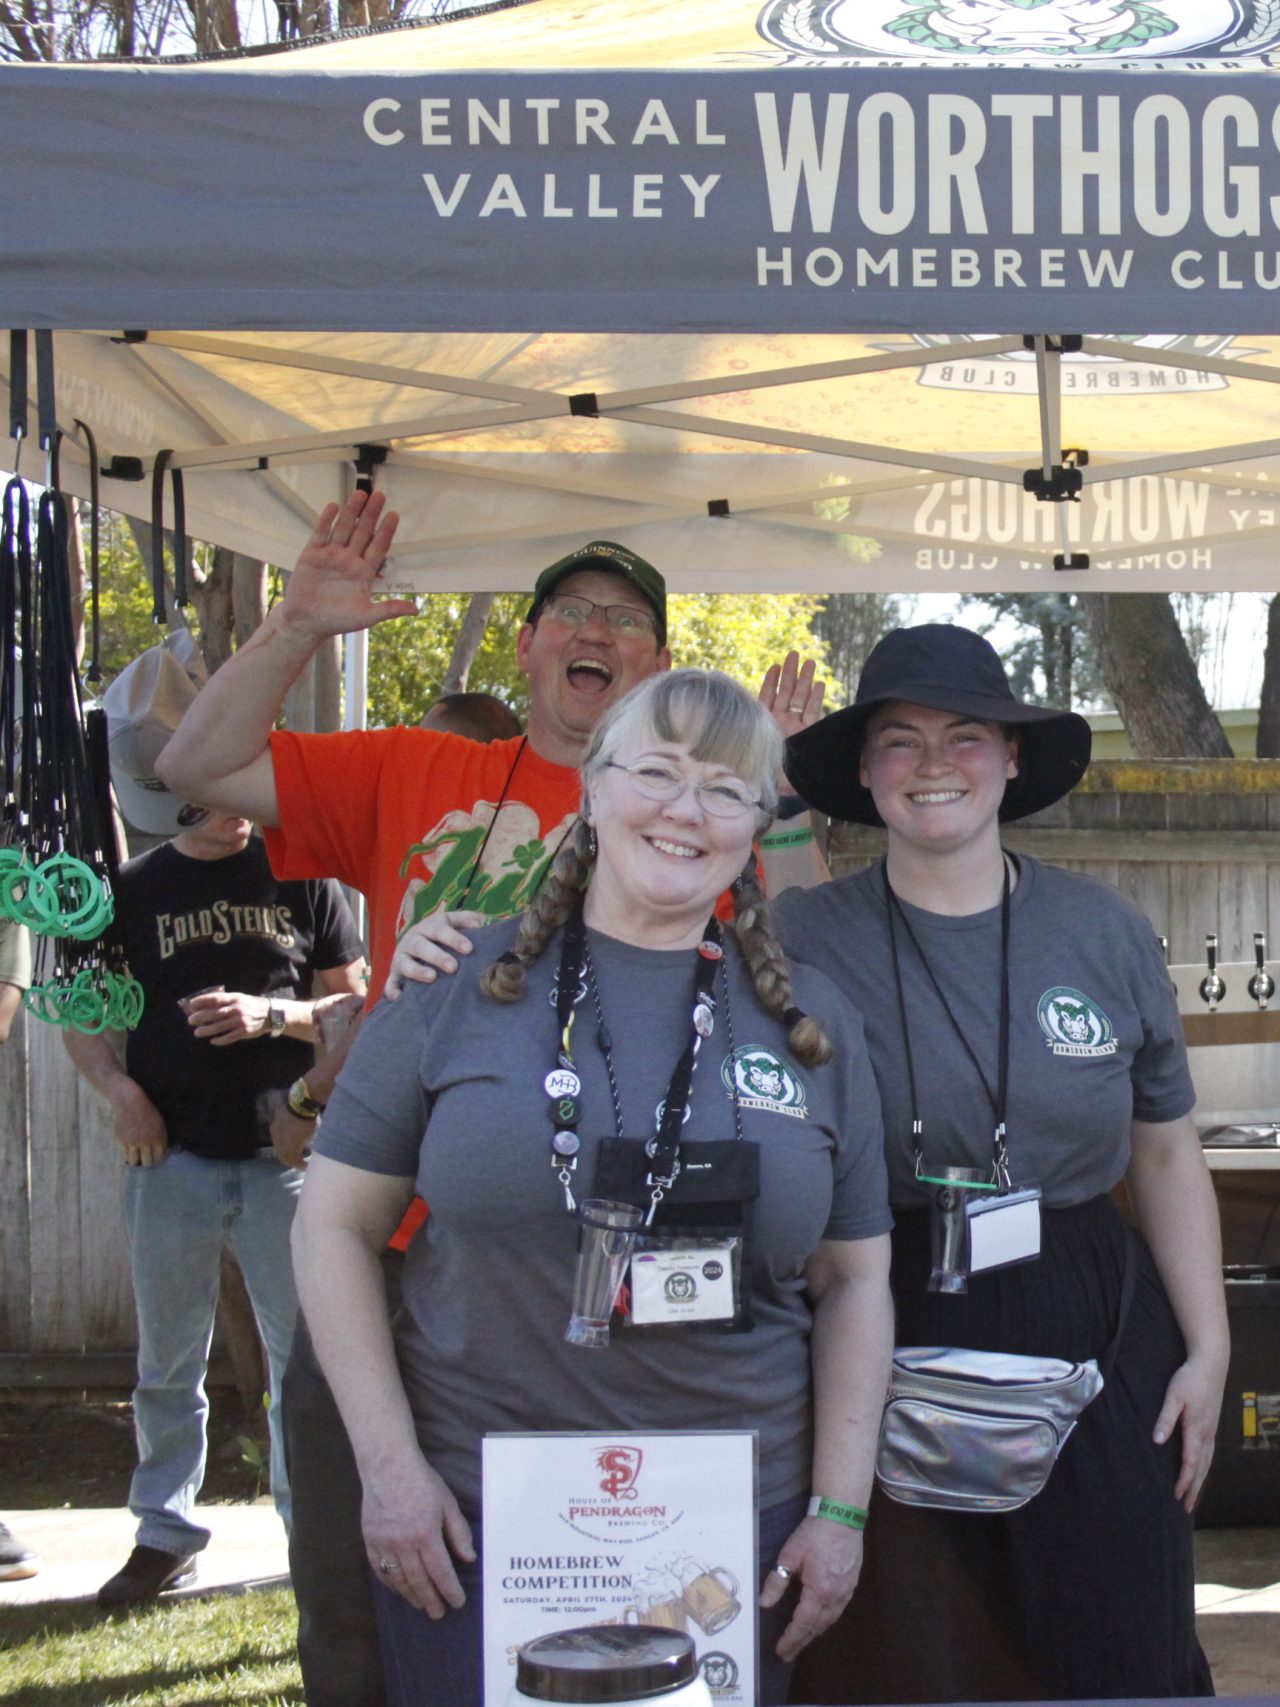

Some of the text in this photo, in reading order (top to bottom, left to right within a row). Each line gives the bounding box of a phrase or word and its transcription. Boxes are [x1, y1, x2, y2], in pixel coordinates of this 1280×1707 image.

[363, 97, 726, 146] CENTRAL
[422, 173, 721, 218] VALLEY
[756, 247, 1135, 289] HOMEBREW
[703, 1266, 722, 1275] 2024
[569, 1505, 667, 1522] PENDRAGON
[509, 1555, 625, 1571] HOMEBREW
[501, 1574, 633, 1590] COMPETITION
[564, 1606, 597, 1614] 12:00pm
